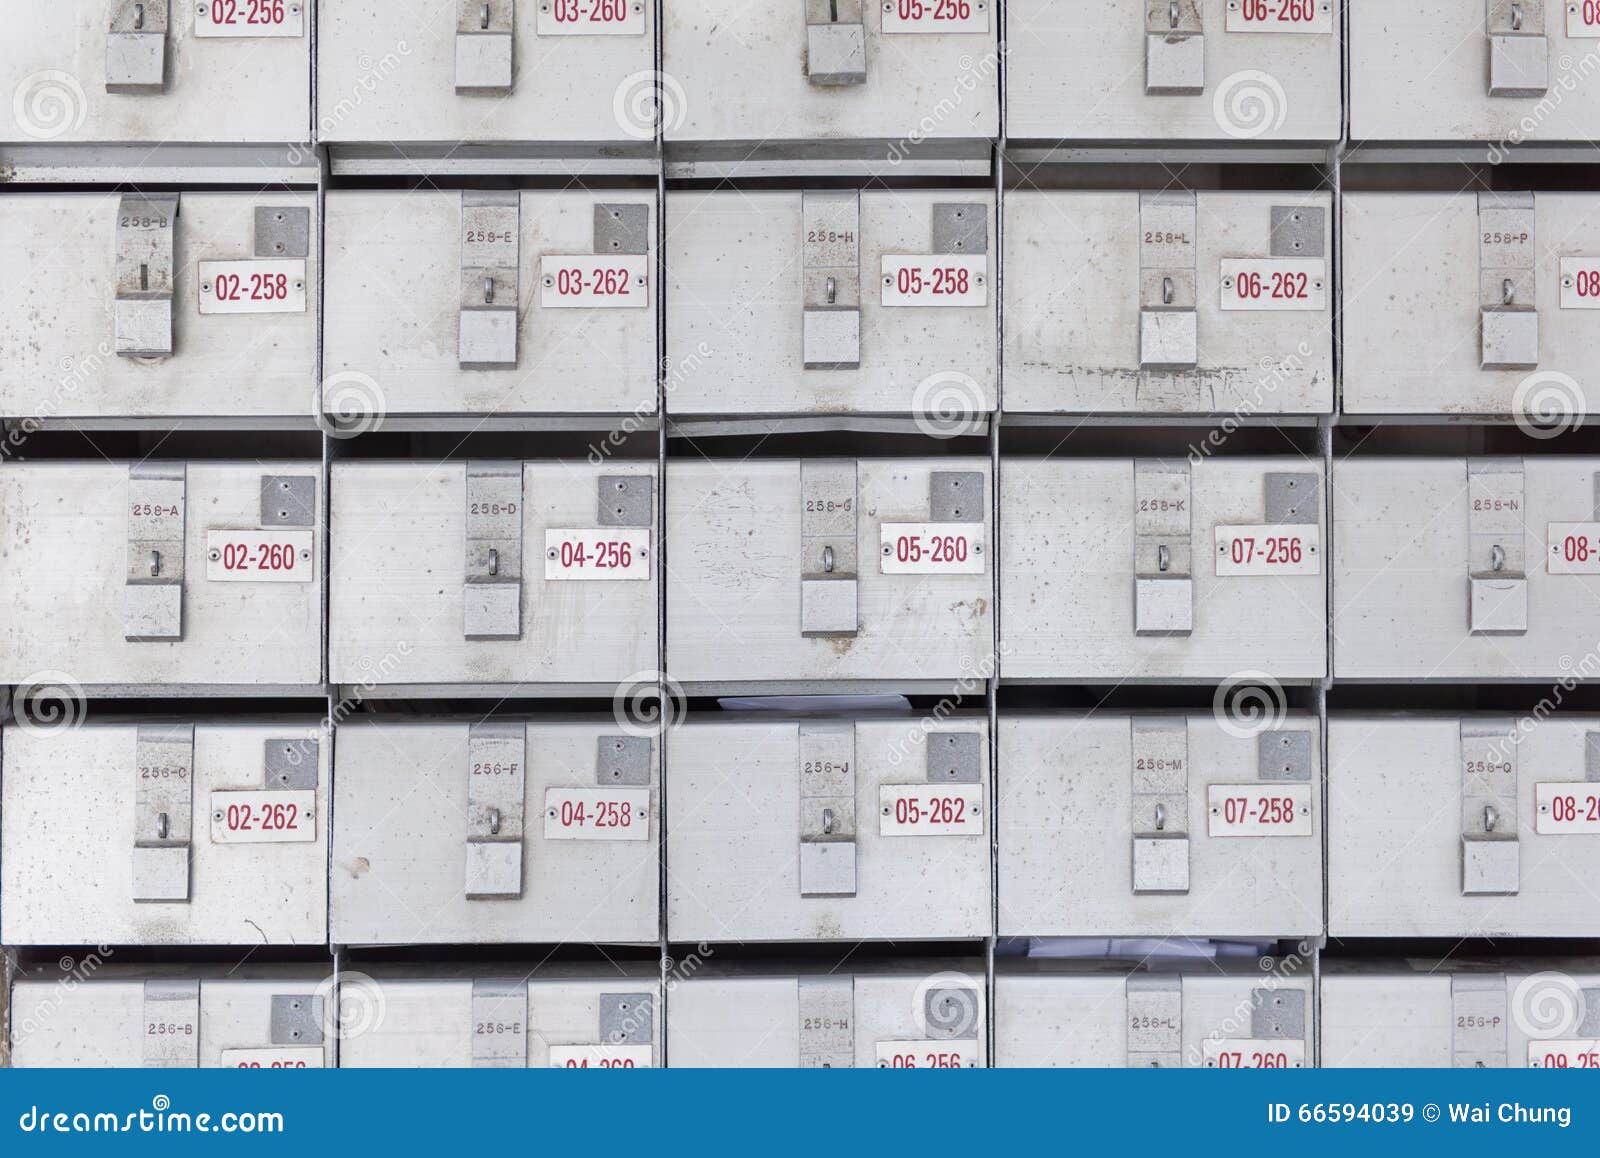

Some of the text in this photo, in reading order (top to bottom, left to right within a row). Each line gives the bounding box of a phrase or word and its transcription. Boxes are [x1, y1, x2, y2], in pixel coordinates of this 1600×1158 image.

[211, 0, 284, 25] 02-256
[554, 0, 627, 23] 03-260
[898, 0, 971, 21] 05-256
[1243, 0, 1314, 22] 06-260
[466, 231, 513, 244] 258-E
[807, 231, 855, 244] 258-H
[1144, 231, 1191, 245] 258-L
[1483, 232, 1529, 245] 258-P
[216, 273, 288, 301] 02-258
[558, 268, 629, 296] 03-262
[897, 267, 969, 294] 05-258
[1237, 271, 1307, 299] 06-262
[132, 503, 179, 517] 258-A
[470, 503, 517, 515] 258-D
[1139, 499, 1186, 512] 258-K
[223, 543, 295, 571] 02-260
[561, 541, 631, 568] 04-256
[897, 535, 967, 562] 05-260
[1232, 537, 1302, 564] 07-256
[1564, 535, 1600, 562] 08-
[473, 763, 519, 776] 256-F
[804, 761, 849, 775] 256-J
[1136, 758, 1183, 771] 256-M
[227, 803, 298, 830] 02-262
[561, 800, 630, 827] 04-258
[895, 797, 964, 824] 05-262
[1225, 797, 1294, 824] 07-258
[1552, 795, 1600, 822] 08-2
[147, 1023, 193, 1036] 256-B
[476, 1023, 521, 1035] 256-E
[803, 1017, 849, 1031] 256-H
[1131, 1017, 1176, 1030] 256-L
[1456, 1016, 1501, 1029] 256-P
[893, 1053, 961, 1068] 06256
